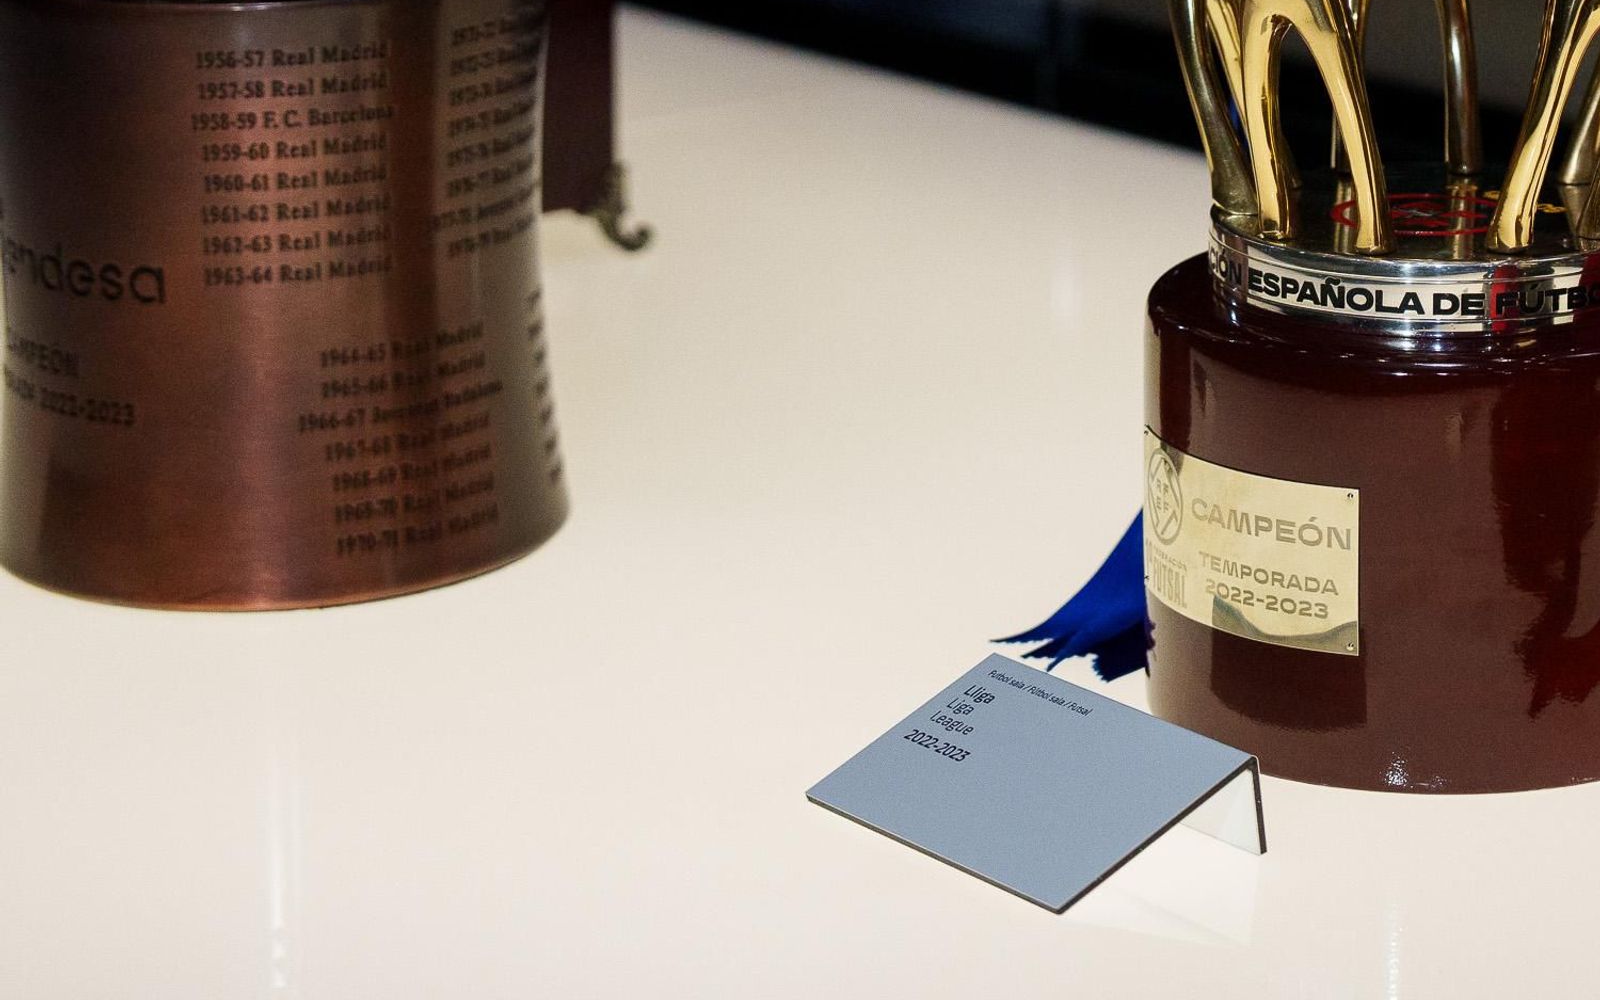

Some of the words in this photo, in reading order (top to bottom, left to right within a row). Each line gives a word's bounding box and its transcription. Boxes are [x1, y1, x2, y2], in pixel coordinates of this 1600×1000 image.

[196, 50, 265, 68] 1956-57
[272, 47, 315, 66] Real
[322, 41, 388, 63] Madrid
[198, 81, 265, 99] 1957-58
[272, 78, 315, 97] Real
[322, 71, 388, 93] Madrid
[191, 112, 257, 130] 1958-59
[308, 105, 393, 126] Barcelona
[202, 142, 269, 161] 1959-60
[277, 139, 318, 158] Real
[324, 132, 387, 155] Madrid
[204, 174, 268, 193] 1960-61
[277, 170, 318, 189] Real
[325, 164, 387, 186] Madrid
[202, 204, 269, 223] 1961-62
[277, 201, 319, 219] Real
[327, 192, 391, 216] Madrid
[204, 235, 271, 253] 1962-63
[279, 232, 321, 250] Real
[328, 223, 392, 247] Madrid
[205, 265, 271, 285] 1963-64
[280, 262, 321, 282] Real
[329, 255, 392, 279] Madrid
[1248, 269, 1426, 314] ESPAÑOLA
[1433, 292, 1485, 316] DE
[1191, 497, 1351, 550] CAMPEÓN
[1198, 551, 1339, 596] TEMPORADA
[1205, 578, 1329, 620] 2022-2023
[946, 697, 975, 716] Liga
[963, 684, 996, 705] Lliga
[930, 710, 975, 736] League
[1067, 702, 1094, 717] Futsal
[903, 728, 972, 763] 2022-2023
